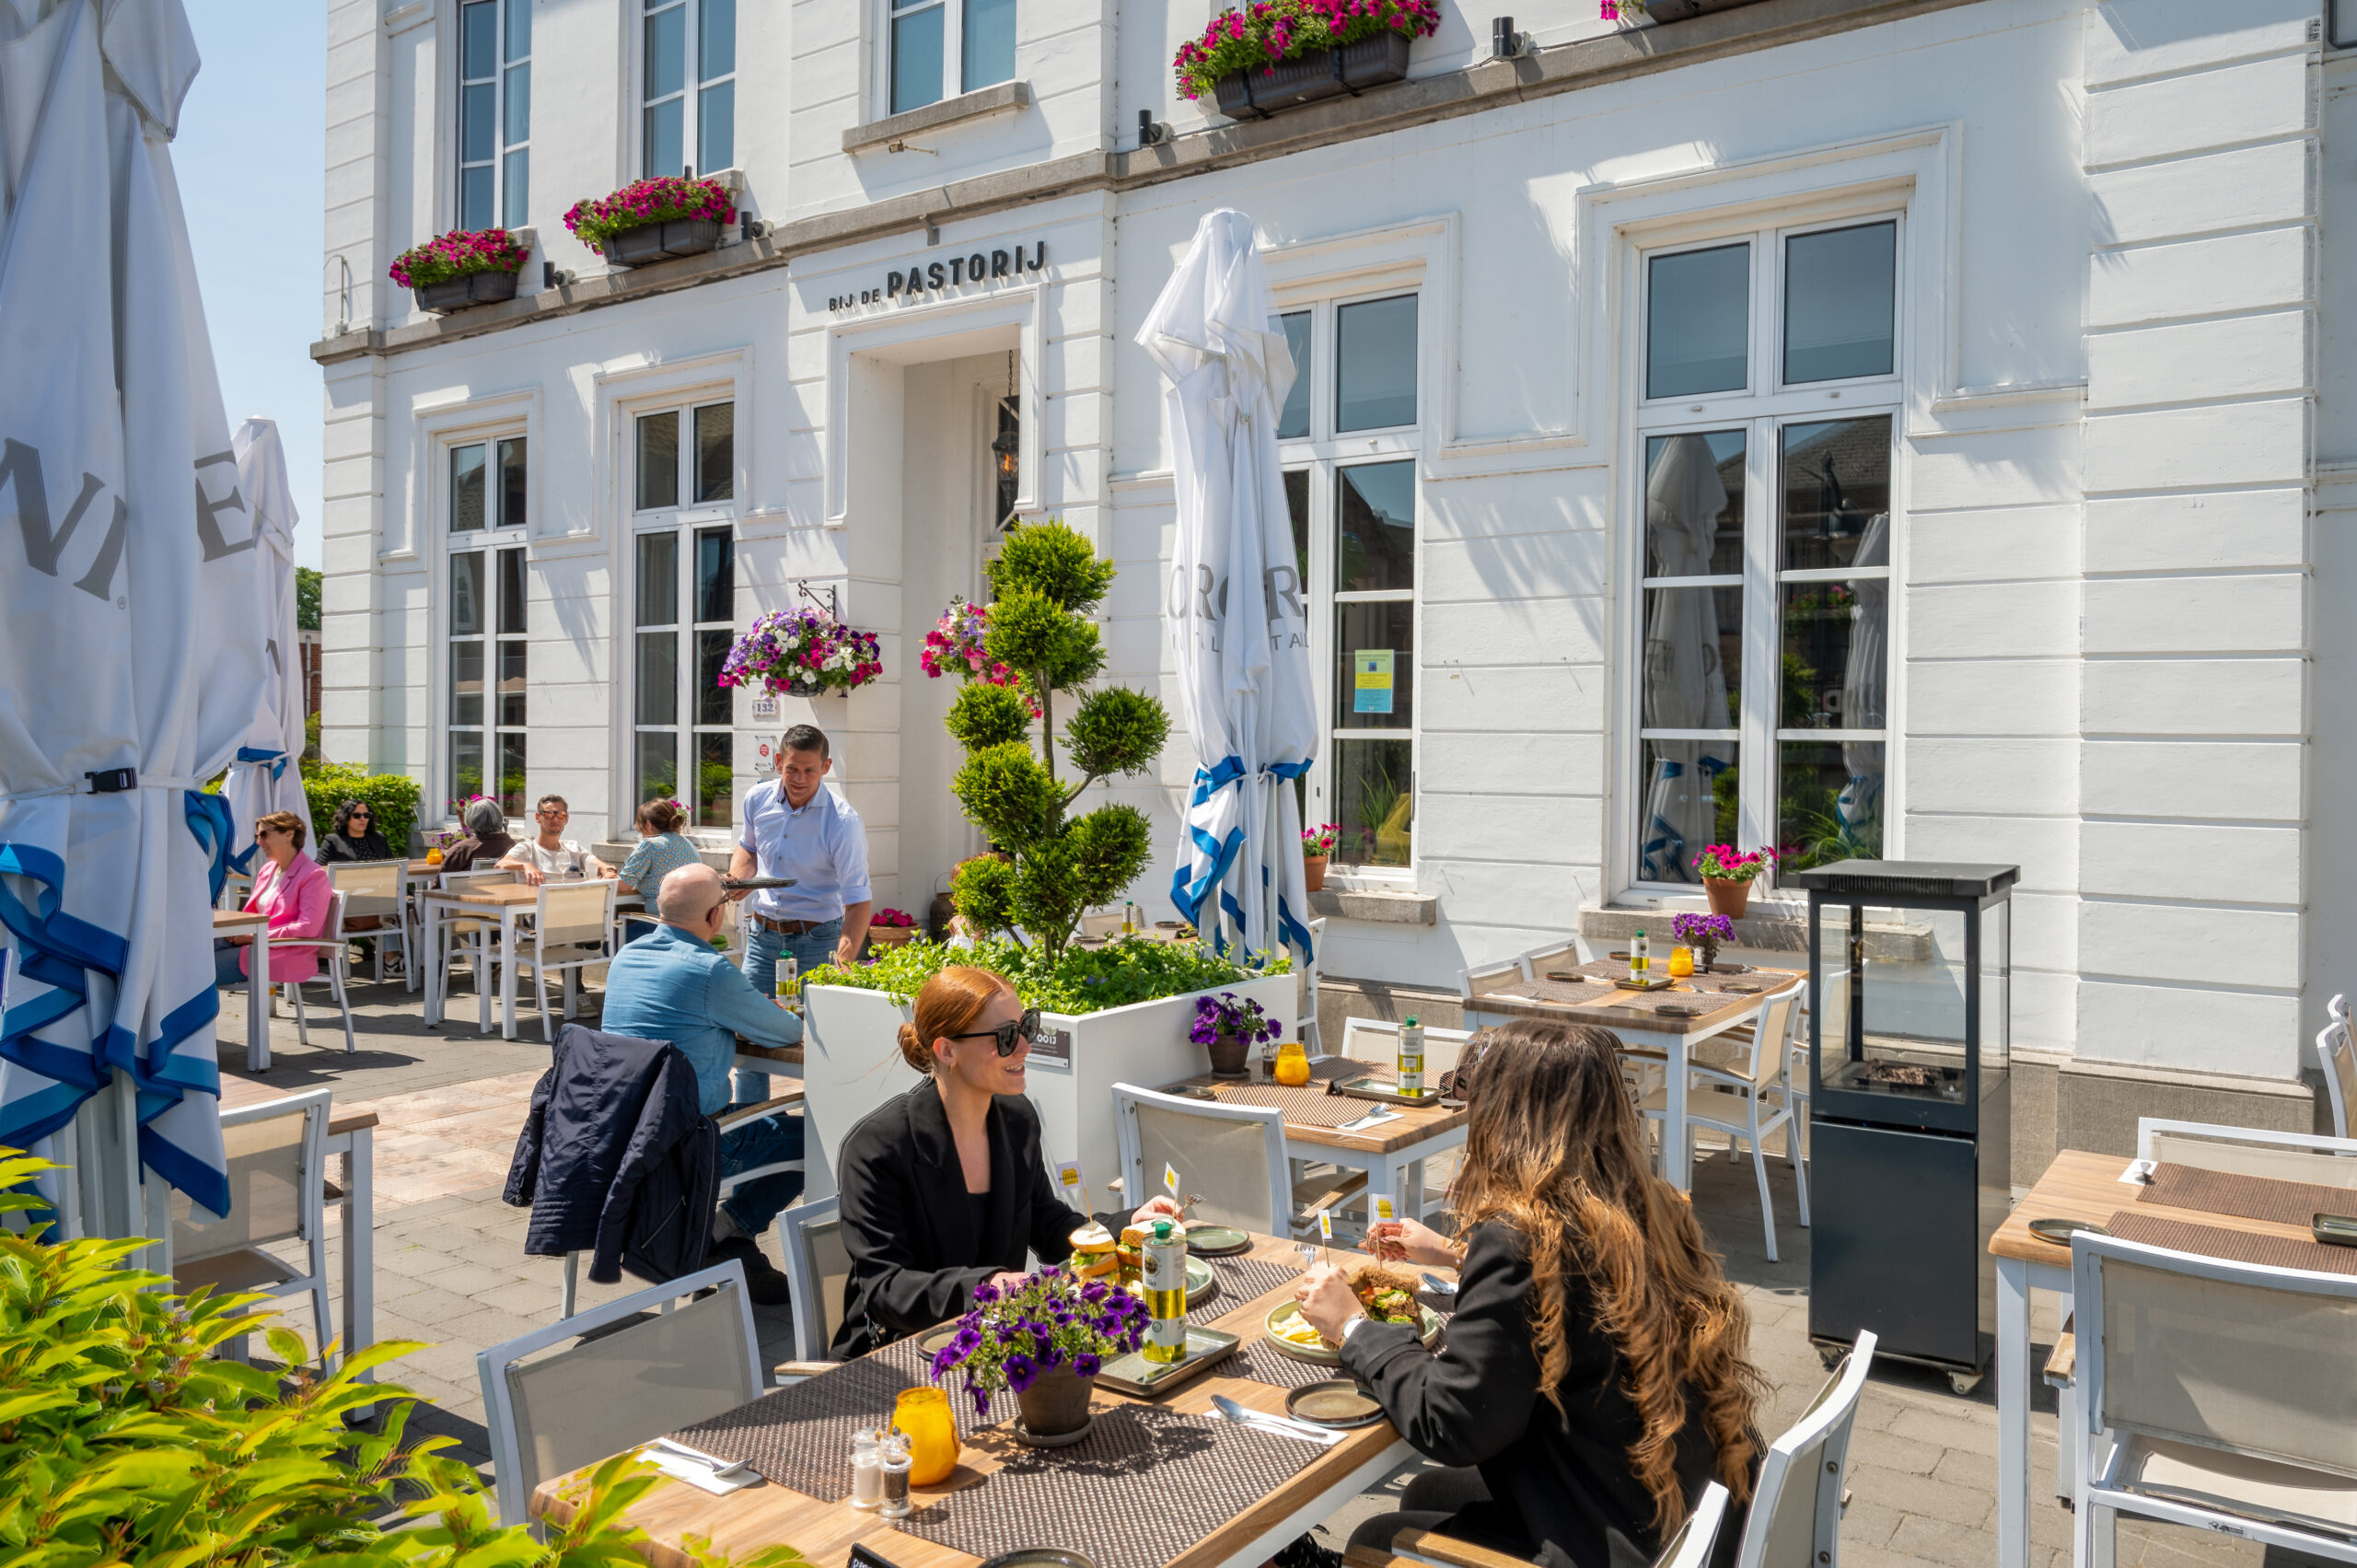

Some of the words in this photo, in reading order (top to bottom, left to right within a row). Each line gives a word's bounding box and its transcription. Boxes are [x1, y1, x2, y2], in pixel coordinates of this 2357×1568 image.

[830, 293, 853, 311] BIJ
[861, 288, 880, 305] DE
[887, 240, 1046, 298] PASTORIJ
[757, 703, 774, 713] 132
